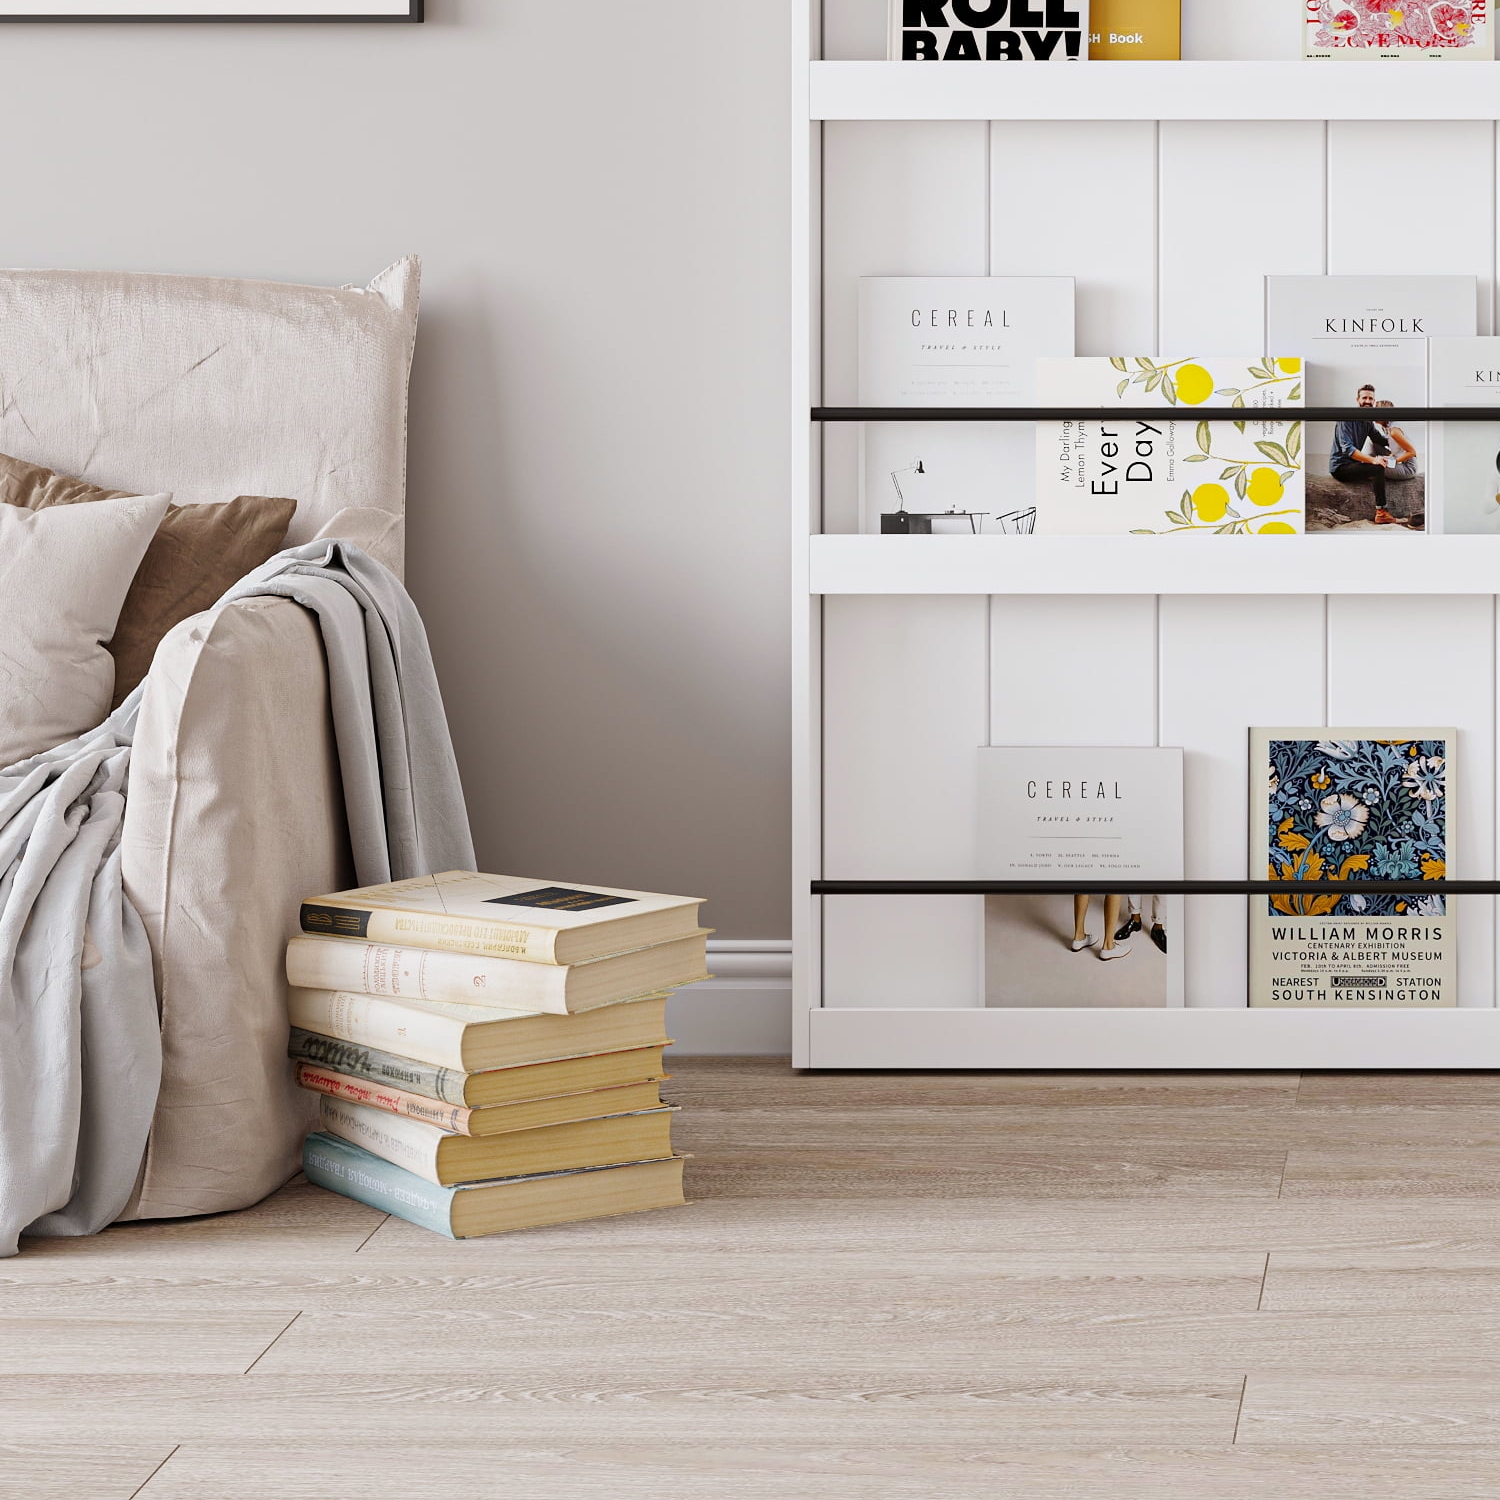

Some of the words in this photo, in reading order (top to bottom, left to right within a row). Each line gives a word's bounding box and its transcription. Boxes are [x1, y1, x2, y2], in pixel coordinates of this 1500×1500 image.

[1109, 32, 1143, 44] Book
[911, 309, 1010, 328] CEREAL
[1325, 318, 1424, 333] KINFOLK
[1059, 421, 1073, 461] Darling
[1074, 421, 1087, 450] Thym
[1091, 420, 1118, 495] Ever
[1126, 421, 1163, 482] Day
[1060, 465, 1072, 482] My
[1075, 453, 1085, 488] Lemon
[1166, 459, 1175, 482] Emma
[1027, 780, 1122, 799] CEREAL
[1272, 927, 1356, 940] WILLIAM
[1366, 927, 1442, 940] MORRIS
[1272, 951, 1328, 961] VICTORIA
[1331, 951, 1340, 961] &
[1342, 951, 1388, 961] ALBERT
[1391, 951, 1442, 961] MUSEUM
[1272, 977, 1320, 987] NEAREST
[1396, 977, 1442, 987] STATION
[1272, 989, 1327, 1001] SOUTH
[1335, 989, 1441, 1001] KENSINGTON
